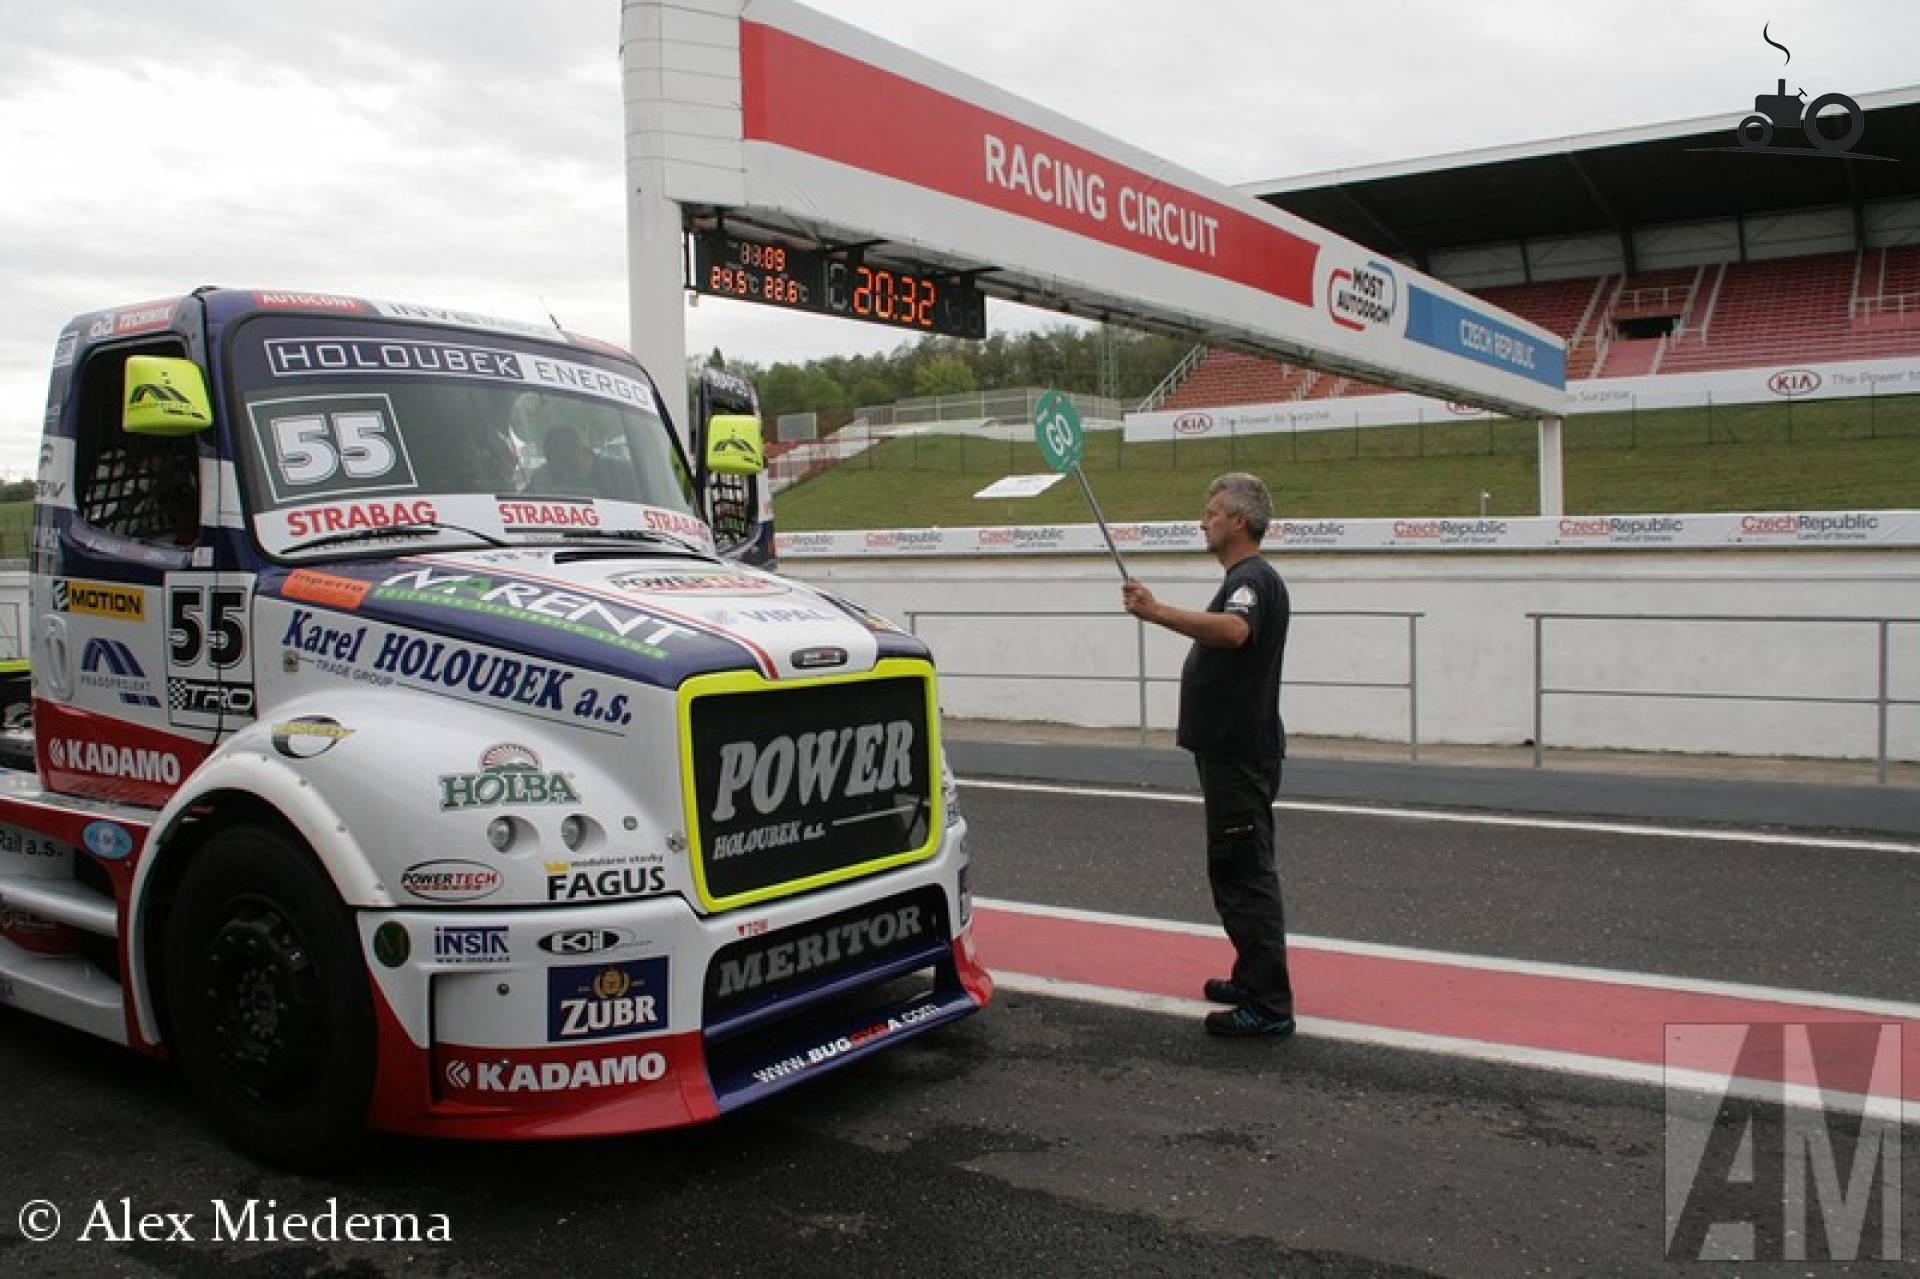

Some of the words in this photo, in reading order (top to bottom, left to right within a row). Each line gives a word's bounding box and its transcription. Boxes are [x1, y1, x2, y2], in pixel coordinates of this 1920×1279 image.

[984, 133, 1107, 221] RACING
[1119, 186, 1218, 257] CIRCUIT
[1353, 268, 1384, 300] MOST
[279, 344, 519, 377] HOLOUBEK
[538, 361, 650, 402] ENERGO
[270, 409, 397, 485] 55
[1045, 414, 1073, 457] GO
[286, 500, 438, 537] STRABAG
[498, 503, 600, 527] STRABAG
[70, 588, 142, 614] MOTION
[168, 584, 248, 670] 55
[282, 609, 367, 663] Karel
[373, 632, 574, 711] HOLOUBEK
[573, 687, 632, 726] a.s.
[66, 740, 181, 785] KADAMO
[712, 720, 914, 821] POWER
[440, 773, 579, 809] HOLBA
[712, 821, 800, 860] HOLOUBEK
[401, 872, 498, 884] POWERTECH
[547, 866, 666, 901] FAGUS
[718, 906, 922, 996] MERITOR
[560, 995, 658, 1035] ZUBR
[477, 1052, 668, 1092] KADAMO
